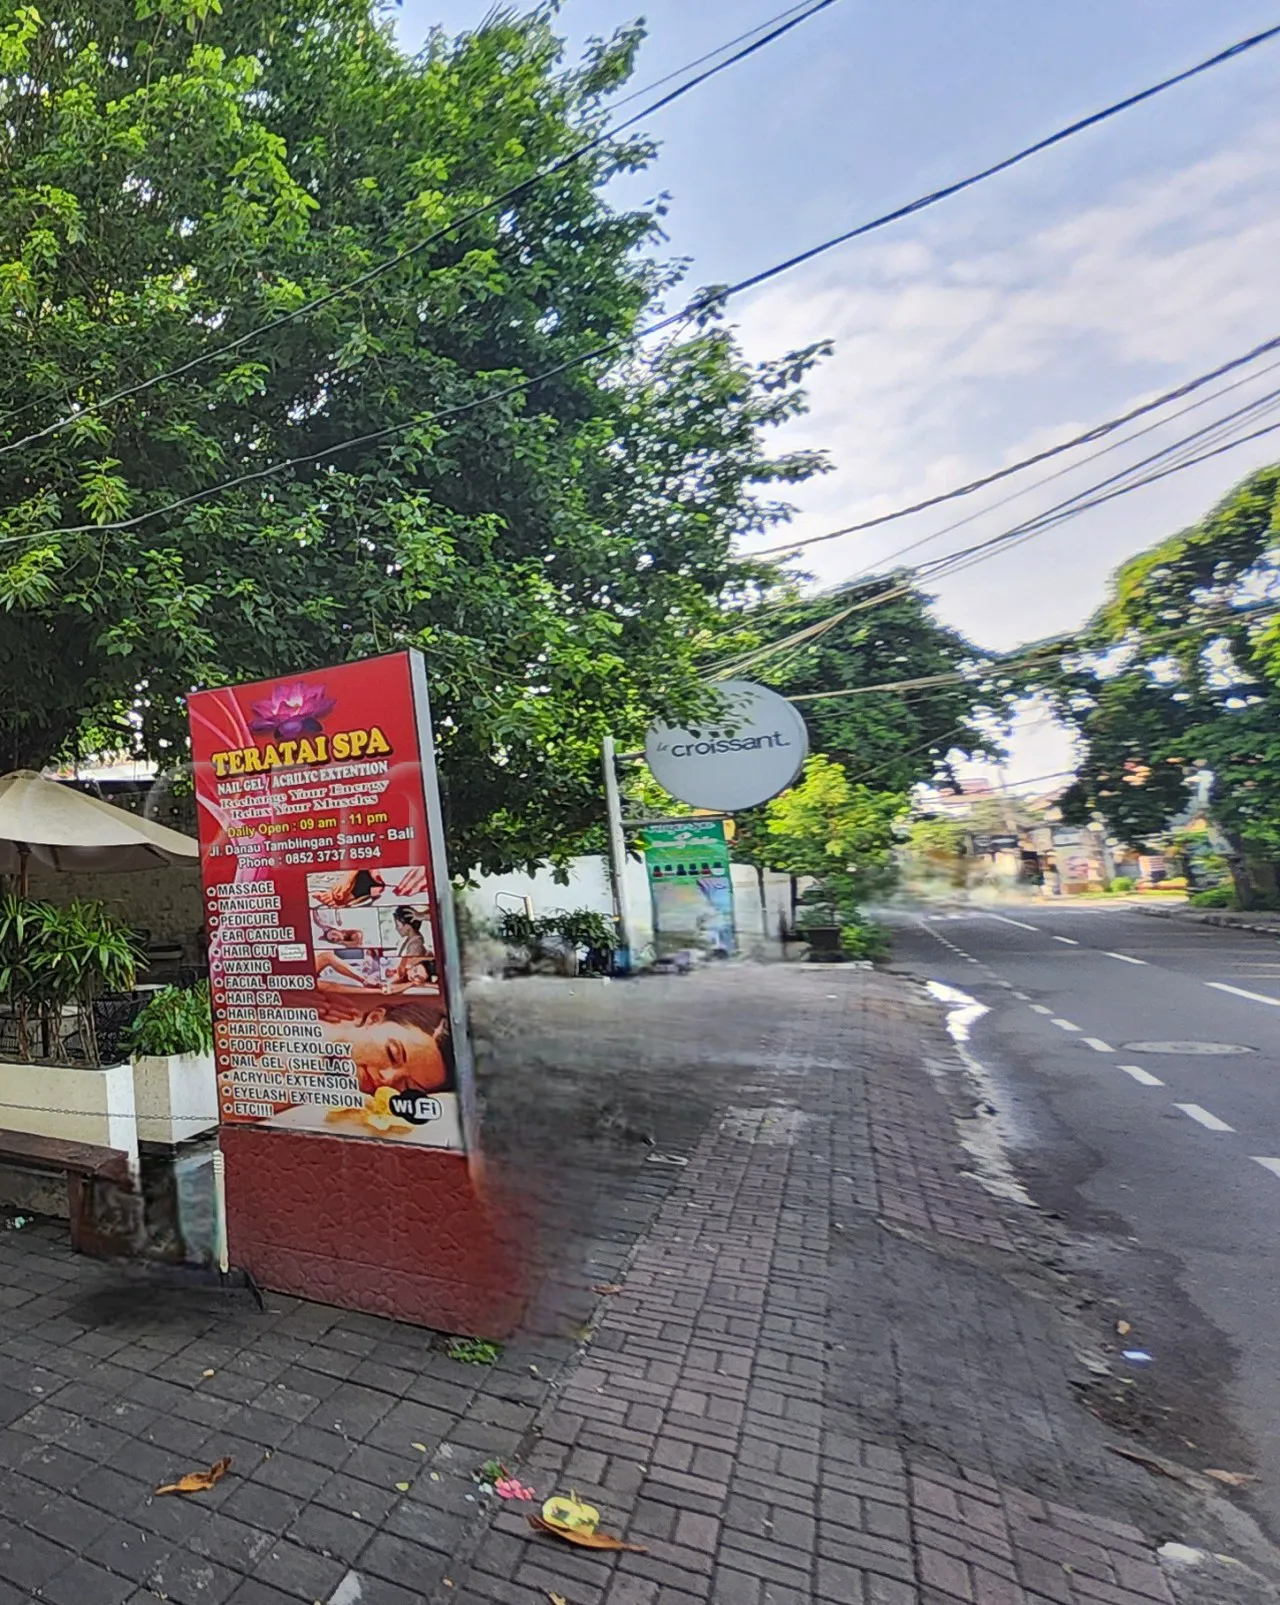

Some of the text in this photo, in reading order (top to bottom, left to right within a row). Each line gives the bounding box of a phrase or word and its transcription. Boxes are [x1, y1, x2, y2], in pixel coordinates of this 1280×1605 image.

[211, 727, 391, 777] TERATAI SPA
[671, 731, 791, 757] croissant
[217, 782, 243, 795] NAIL
[243, 779, 265, 791] GEL
[272, 771, 319, 788] ACRILYC
[320, 761, 388, 781] EXTENTION
[221, 780, 389, 810] Recharge Your Energy
[231, 795, 378, 821] Relax Your Muscles
[227, 825, 256, 839] Daily
[258, 822, 290, 836] Open
[299, 818, 315, 830] 09
[317, 817, 337, 828] am
[349, 813, 363, 825] 11
[366, 812, 388, 827] pm
[225, 842, 261, 855] Danau
[265, 836, 333, 853] Tamblingan
[336, 832, 376, 845] Sanur
[387, 827, 415, 841] Bali
[238, 856, 275, 870] Phone
[285, 852, 314, 865] 0852
[317, 849, 346, 862] 3737
[349, 846, 381, 860] 8594
[217, 882, 274, 896] MASSAGE
[219, 897, 280, 911] MANICURE
[220, 913, 278, 926] PEDICURE
[221, 928, 294, 941] EAR CANDLE
[223, 946, 250, 957] HAIR
[253, 945, 276, 957] CUT
[223, 961, 271, 973] WAXING
[225, 976, 314, 989] FACIAL BIOKOS
[226, 992, 281, 1004] HAIR SPA
[228, 1008, 317, 1021] HAIR BRAIDING
[229, 1025, 323, 1038] HAIR COLORING
[230, 1040, 352, 1056] FOOT REFLEXOLOGY
[231, 1057, 356, 1076] NAIL GEL (SHELLAC)
[233, 1073, 359, 1091] ACRYLIC EXTENSION
[233, 1087, 364, 1108] EYELASH EXTENSION
